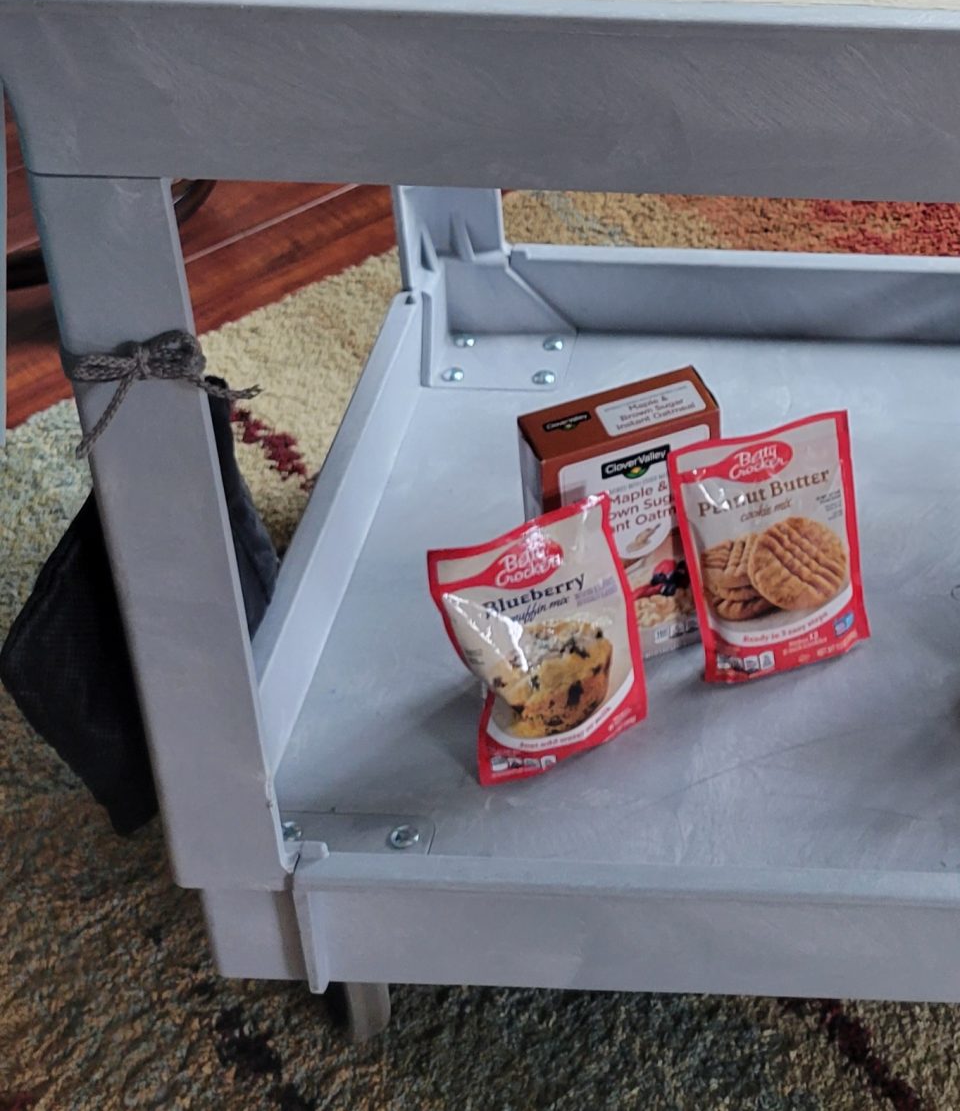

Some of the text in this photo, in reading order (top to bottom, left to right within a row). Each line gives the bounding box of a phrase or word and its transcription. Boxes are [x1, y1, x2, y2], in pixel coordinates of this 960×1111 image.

[729, 456, 786, 480] Crocker
[734, 444, 778, 467] Betty
[610, 486, 654, 505] Maple
[658, 480, 668, 492] &
[769, 469, 830, 498] Butter
[608, 494, 673, 521] own Sug
[740, 498, 793, 522] cookie mix
[482, 573, 585, 619] Blueberry
[510, 596, 570, 625] muffin mix
